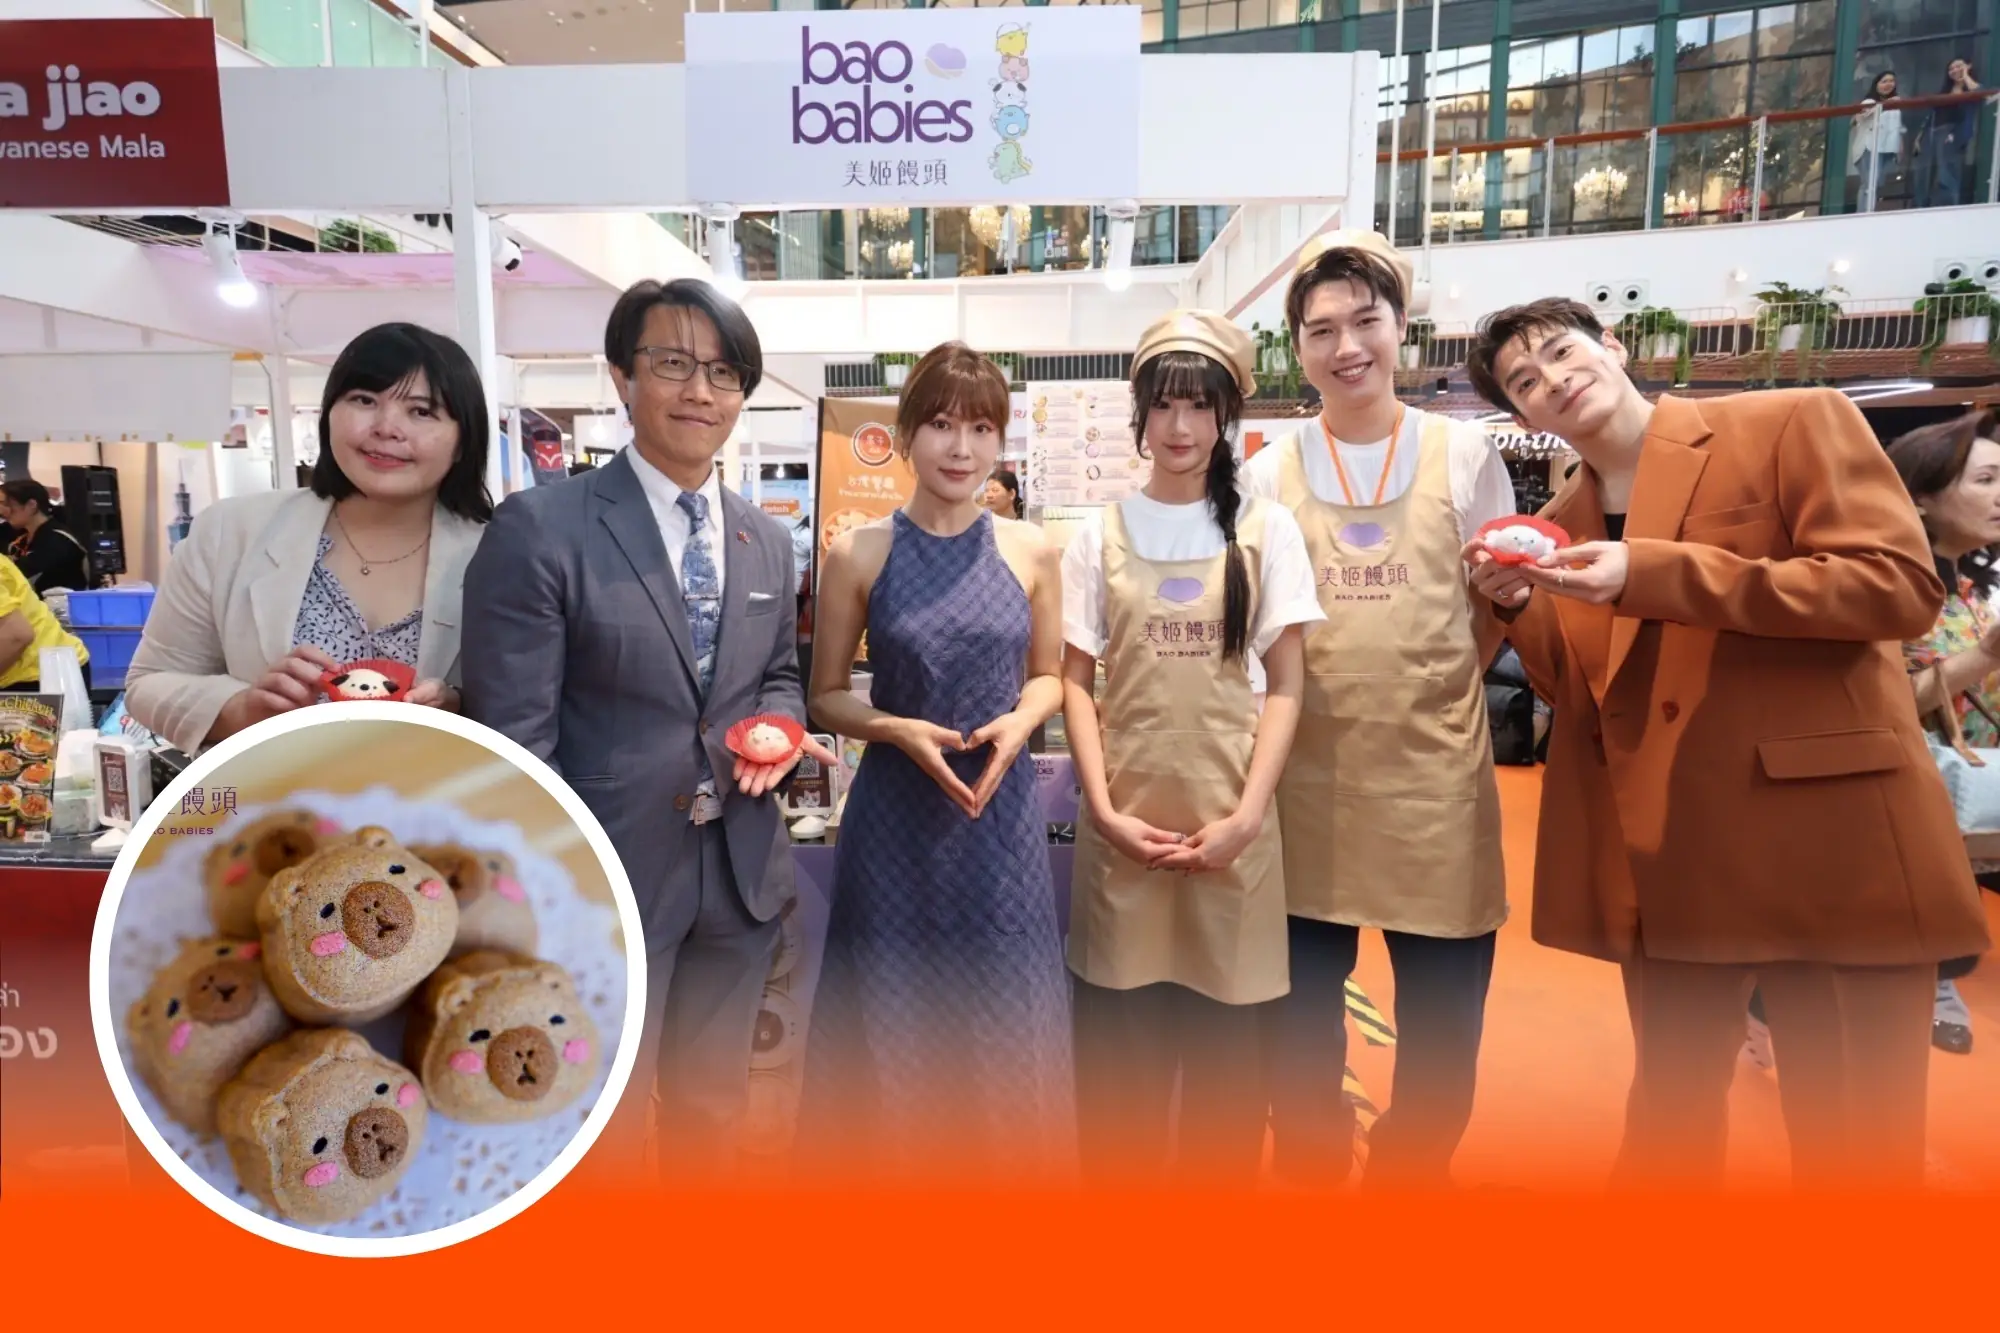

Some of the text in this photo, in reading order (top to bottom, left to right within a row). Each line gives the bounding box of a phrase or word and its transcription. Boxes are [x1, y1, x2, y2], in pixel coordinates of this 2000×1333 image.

[801, 25, 913, 85] bao
[42, 64, 162, 131] jiao
[792, 84, 974, 144] babies
[0, 133, 166, 159] anese Mala
